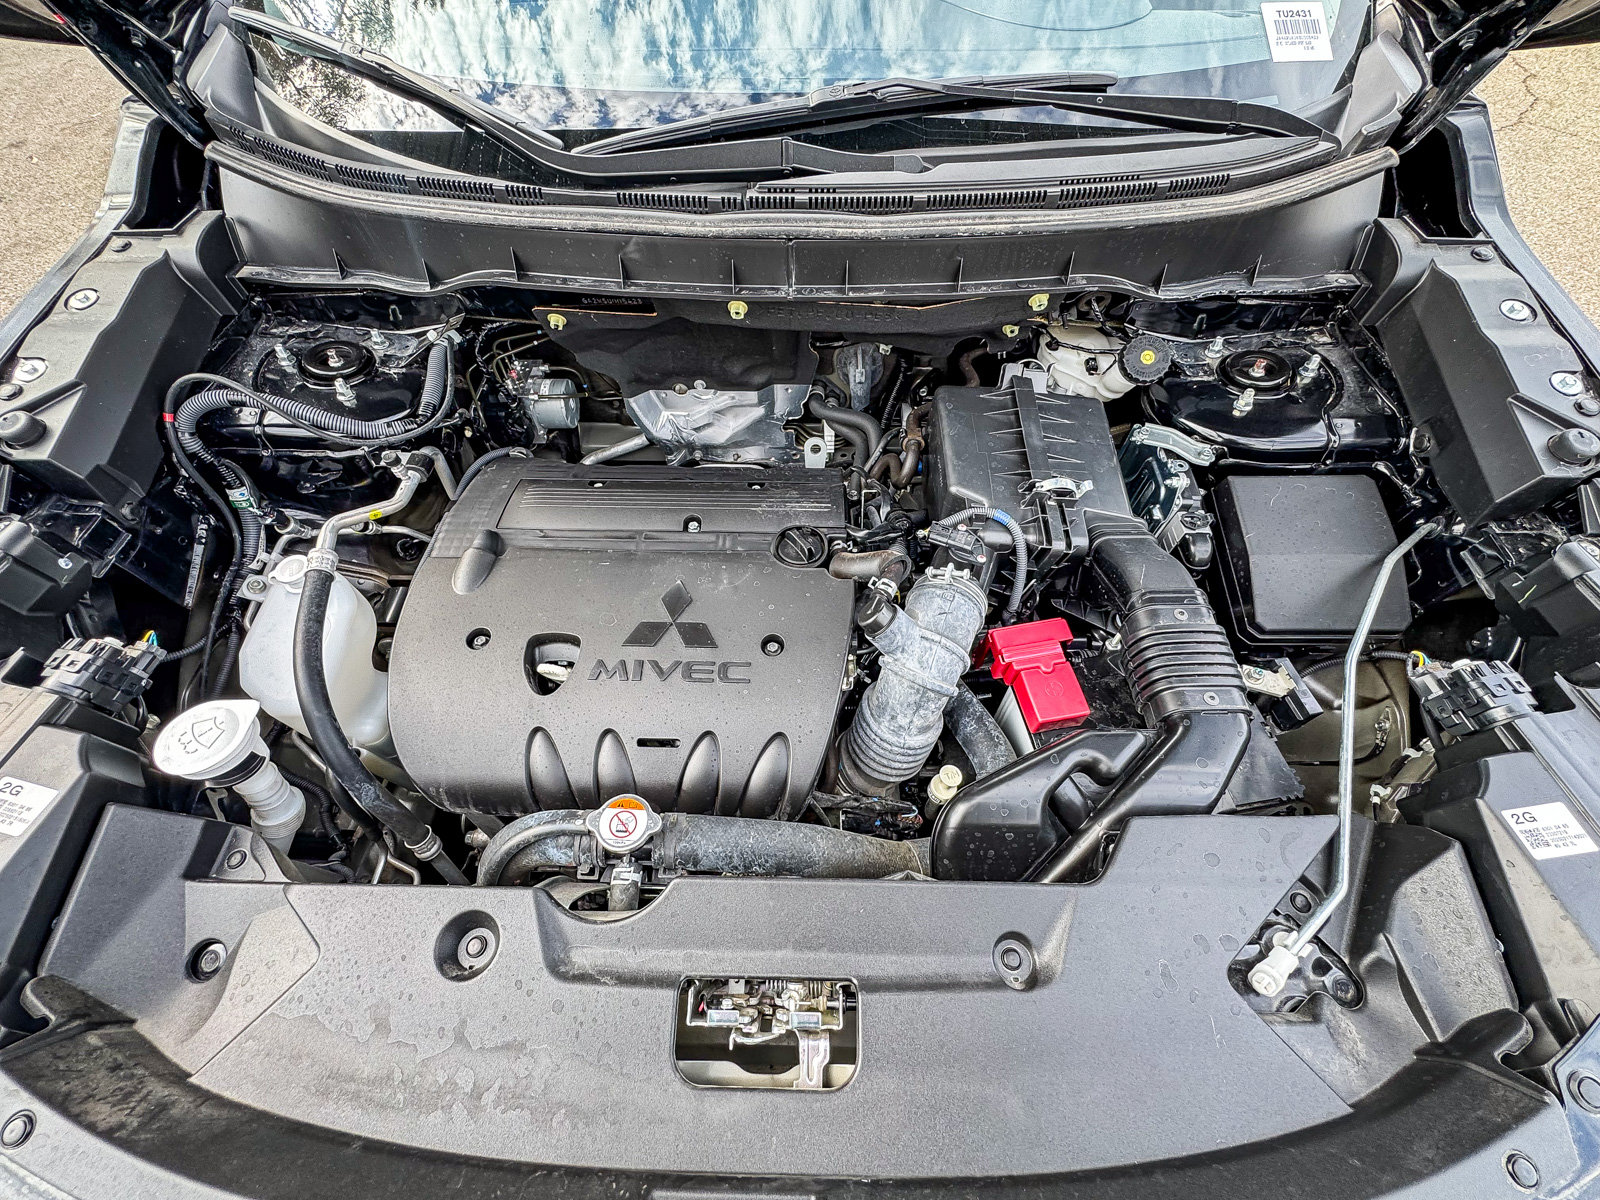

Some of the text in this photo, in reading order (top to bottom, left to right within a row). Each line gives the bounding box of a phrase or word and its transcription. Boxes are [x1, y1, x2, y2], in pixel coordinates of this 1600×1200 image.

[1275, 9, 1312, 18] TU2431
[587, 658, 751, 684] MIVEC
[0, 782, 24, 796] 2G
[1511, 811, 1538, 825] 2G
